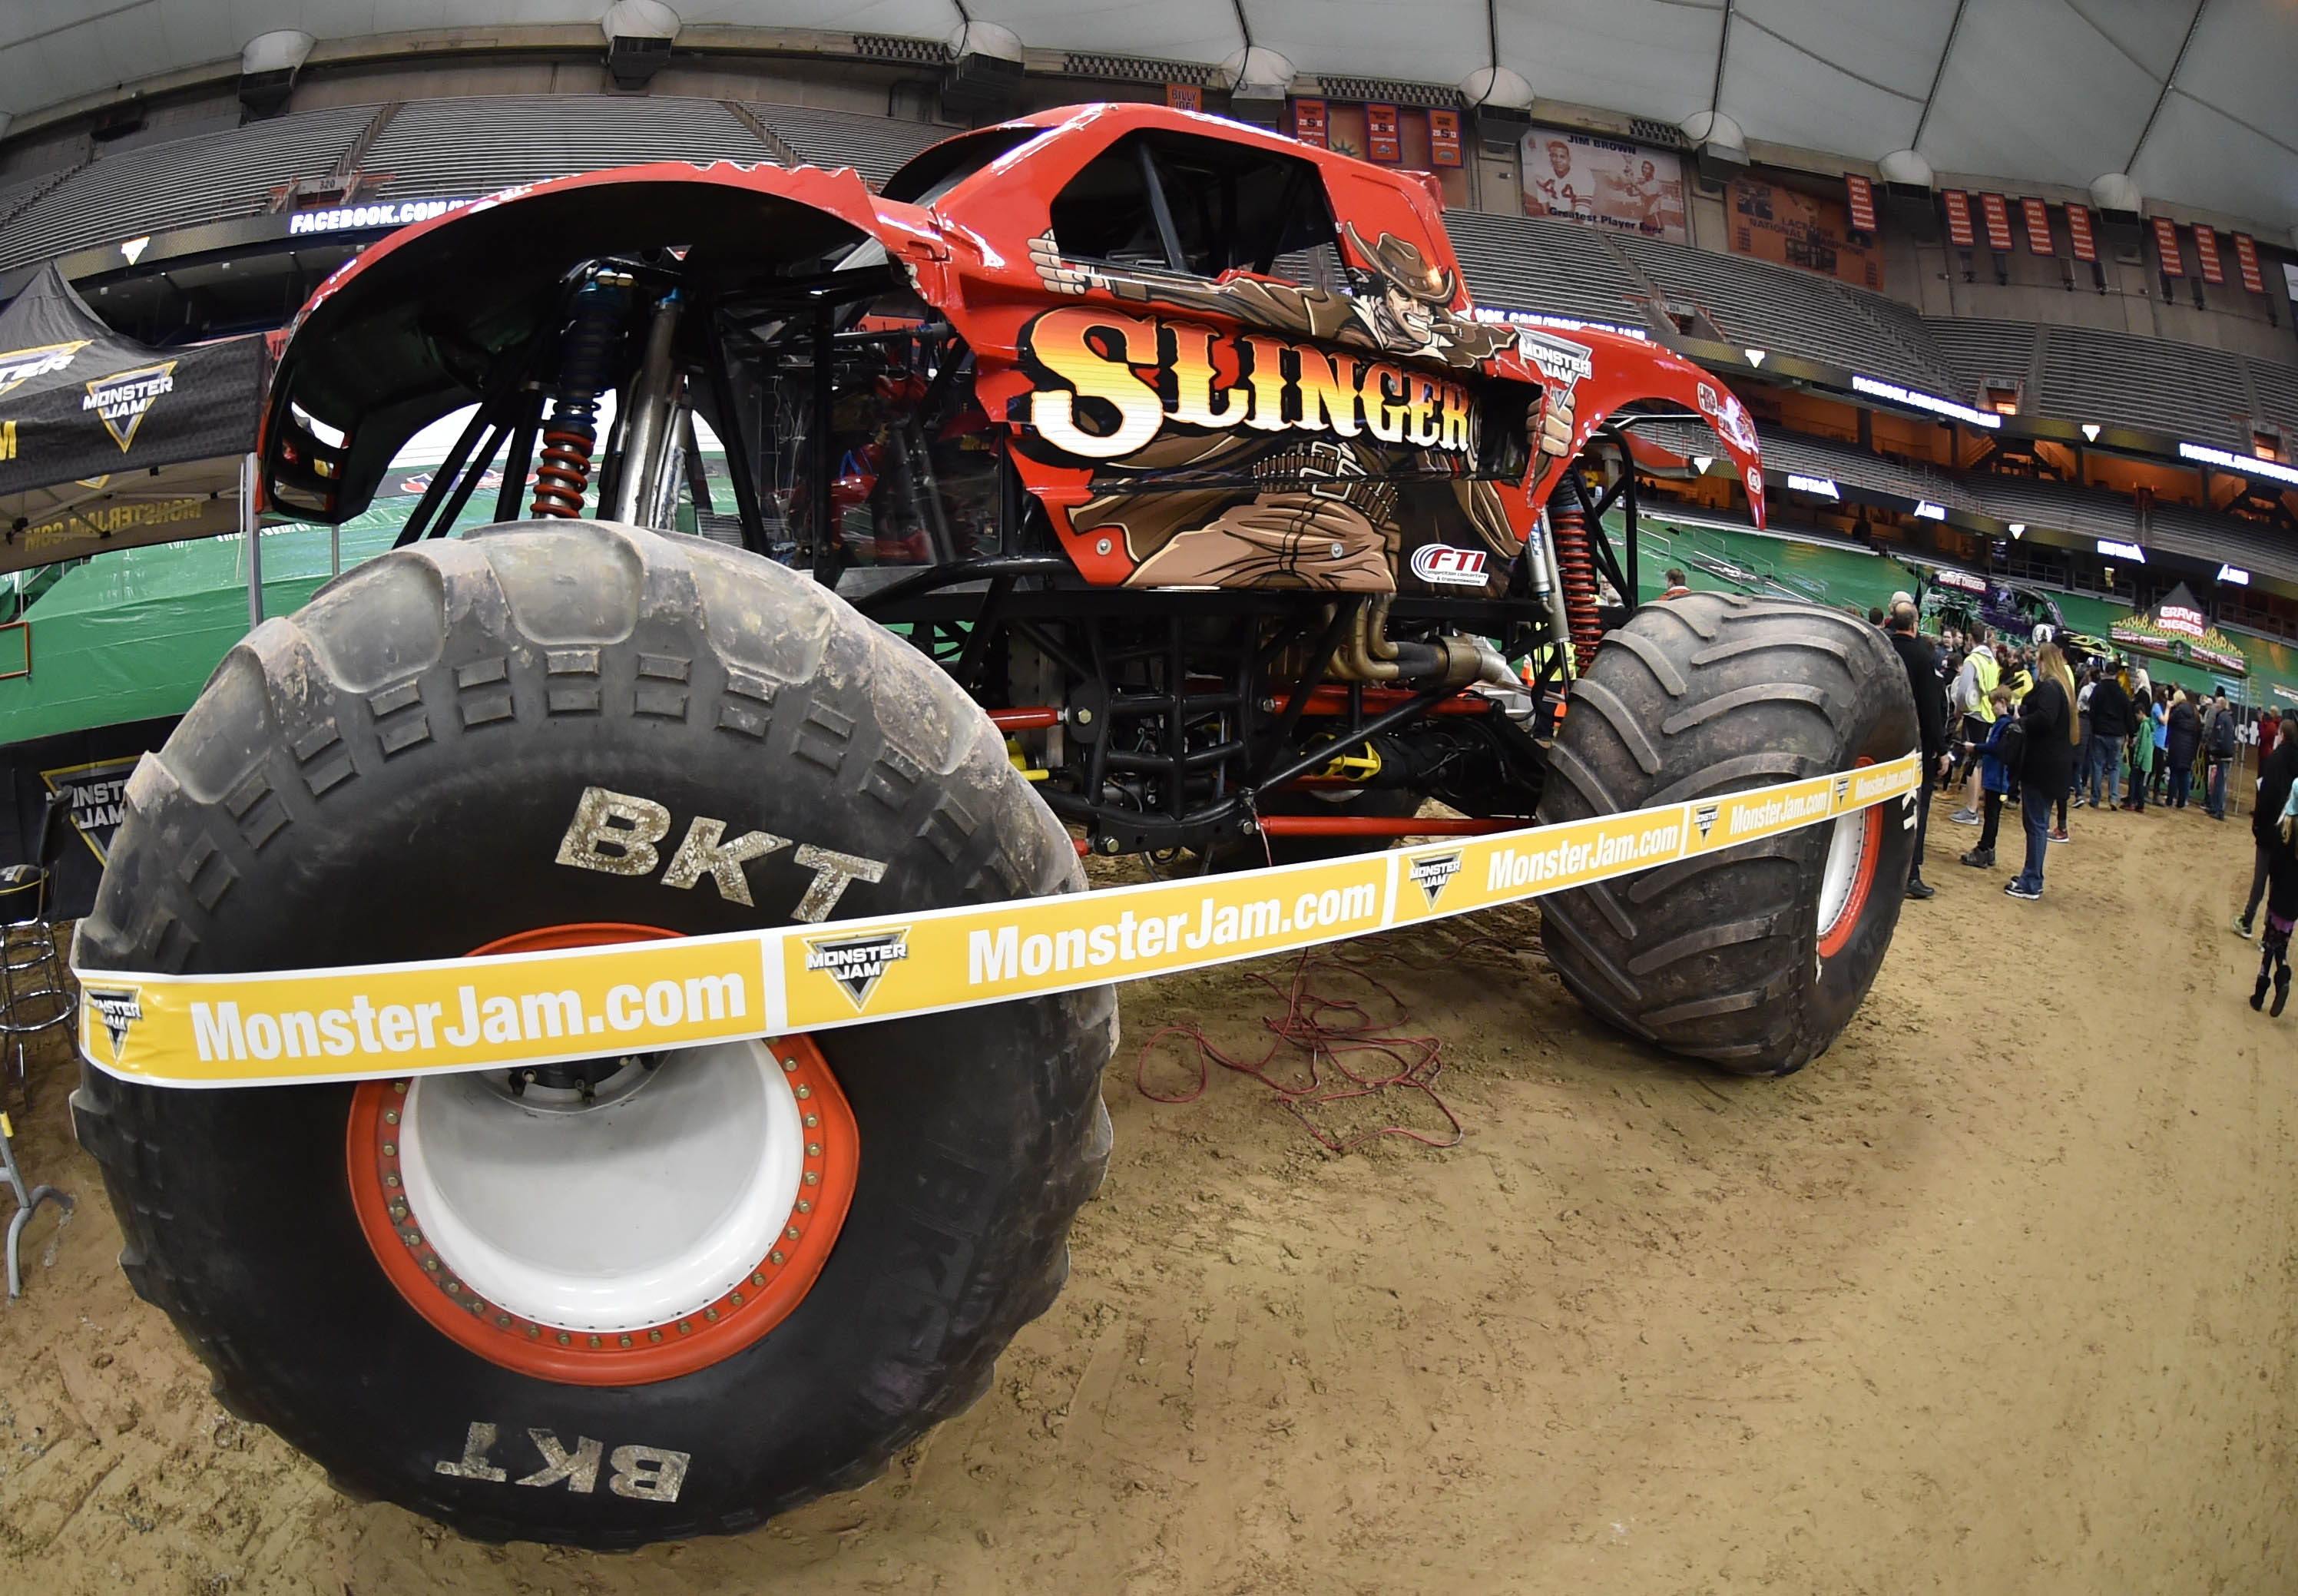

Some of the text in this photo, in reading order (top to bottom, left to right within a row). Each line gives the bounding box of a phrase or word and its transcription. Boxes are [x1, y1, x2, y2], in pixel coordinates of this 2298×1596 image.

[1172, 89, 1197, 101] BILLY
[1568, 135, 1637, 155] JIM BROWN
[1548, 207, 1598, 224] Greatest
[1600, 215, 1636, 230] Player
[1521, 343, 1592, 375] MONSTER
[1031, 306, 1469, 458] SLINGER
[1545, 364, 1574, 384] JAM
[83, 376, 174, 411] MONSTER
[104, 397, 147, 419] JAM
[1429, 548, 1485, 572] FTI
[2160, 605, 2202, 625] GRAVE
[2158, 618, 2204, 637] DIGGER
[79, 805, 124, 829] JAM
[1730, 792, 1827, 835] MonsterJam.com
[555, 785, 889, 923] BKT
[1487, 824, 1678, 891] MonsterJam.com
[1410, 860, 1462, 879] MONSTER
[1423, 874, 1447, 888] JAM
[968, 879, 1376, 985] MonsterJam.com
[806, 943, 909, 971] MONSTER
[836, 961, 883, 981] JAM
[190, 972, 747, 1063] MonsterJam.com
[435, 1421, 691, 1503] BKT
